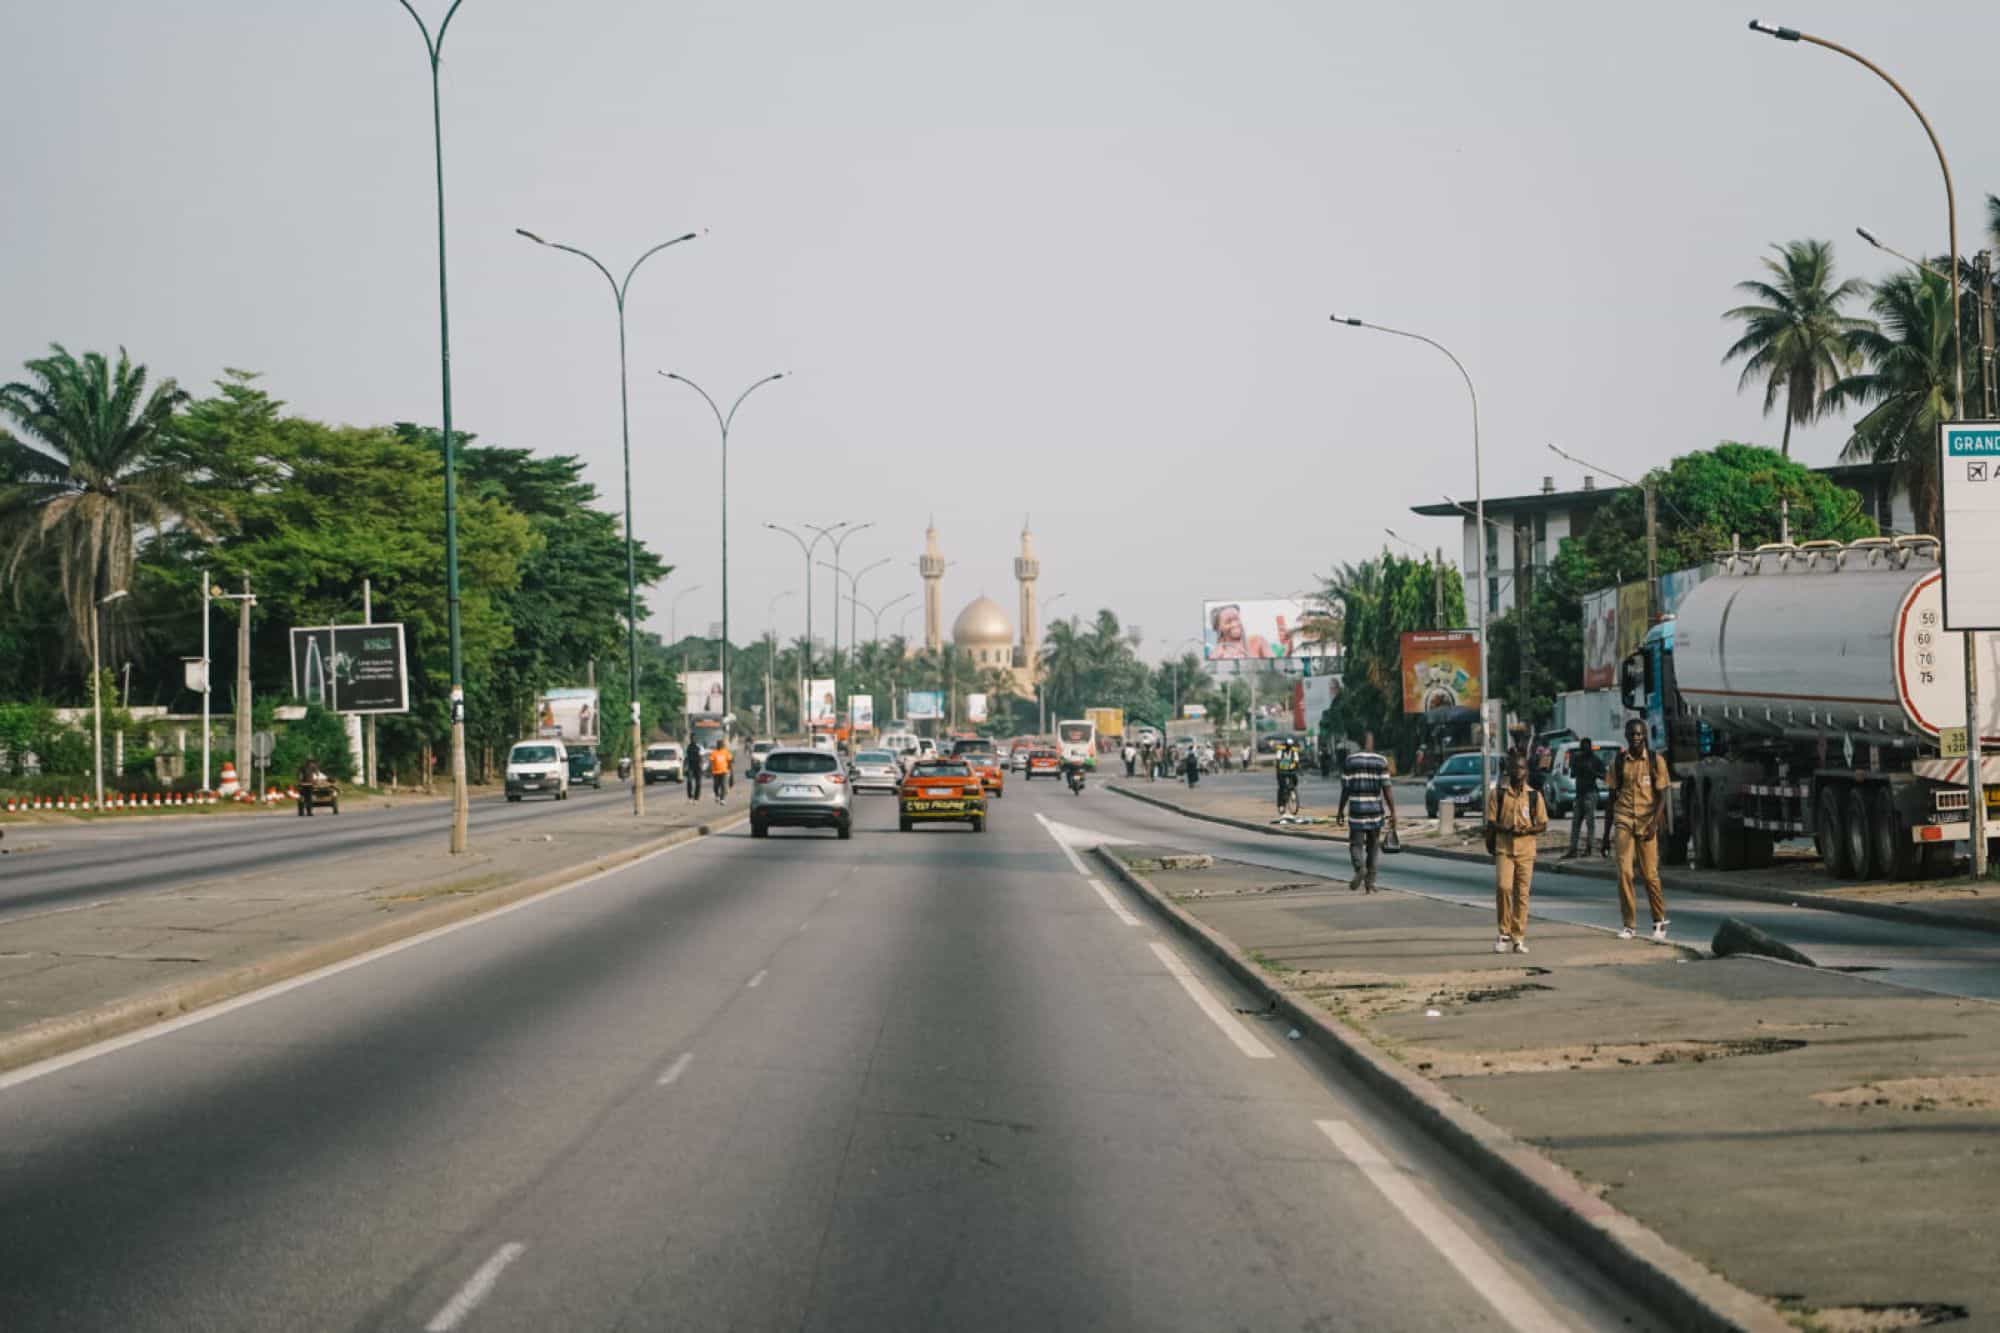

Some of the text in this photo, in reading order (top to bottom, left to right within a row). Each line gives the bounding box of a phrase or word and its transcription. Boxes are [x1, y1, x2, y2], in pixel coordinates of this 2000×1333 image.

[1922, 612, 1935, 624] 50
[1918, 633, 1931, 645] 60
[1920, 653, 1932, 664] 70
[1920, 671, 1933, 683] 75
